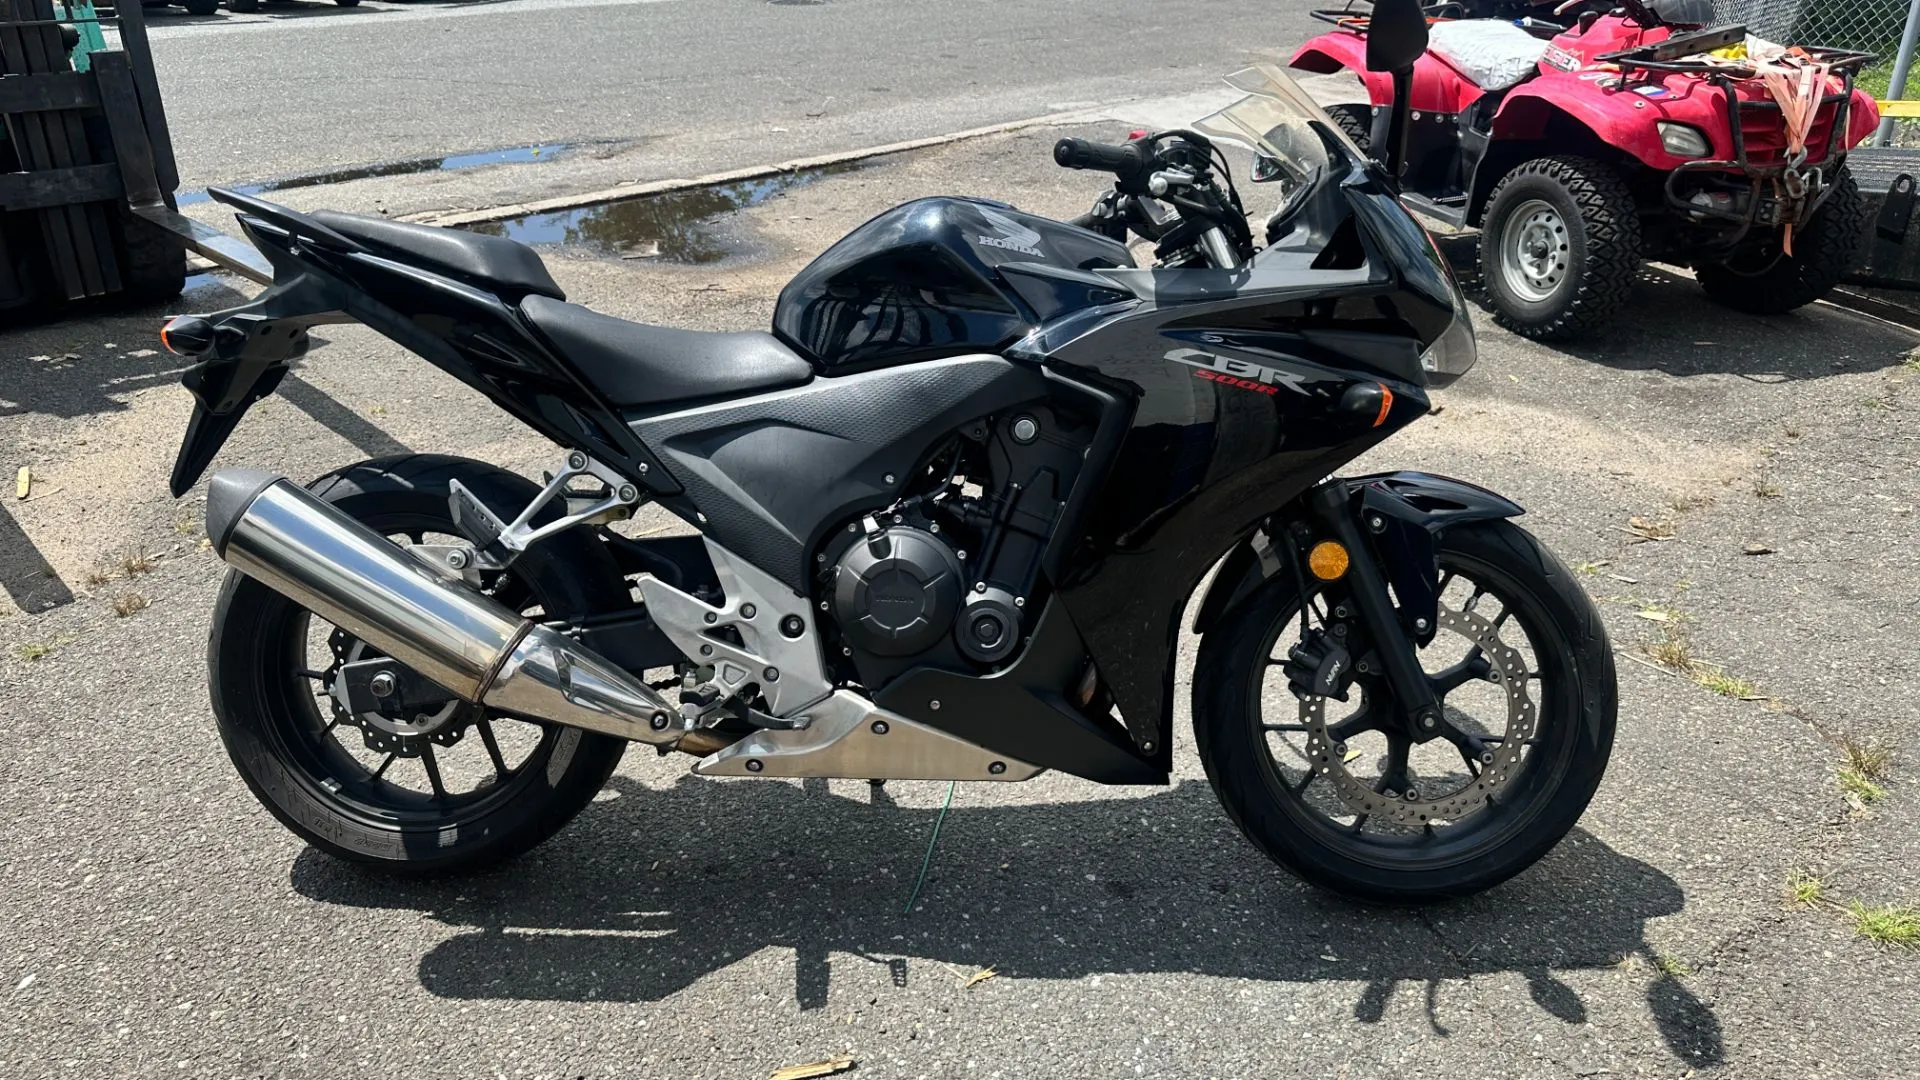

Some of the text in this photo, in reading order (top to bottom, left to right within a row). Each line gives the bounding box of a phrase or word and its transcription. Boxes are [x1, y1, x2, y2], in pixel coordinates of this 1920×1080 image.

[978, 235, 1045, 257] HONDA
[1163, 348, 1312, 396] CBR
[1193, 368, 1280, 395] 500R
